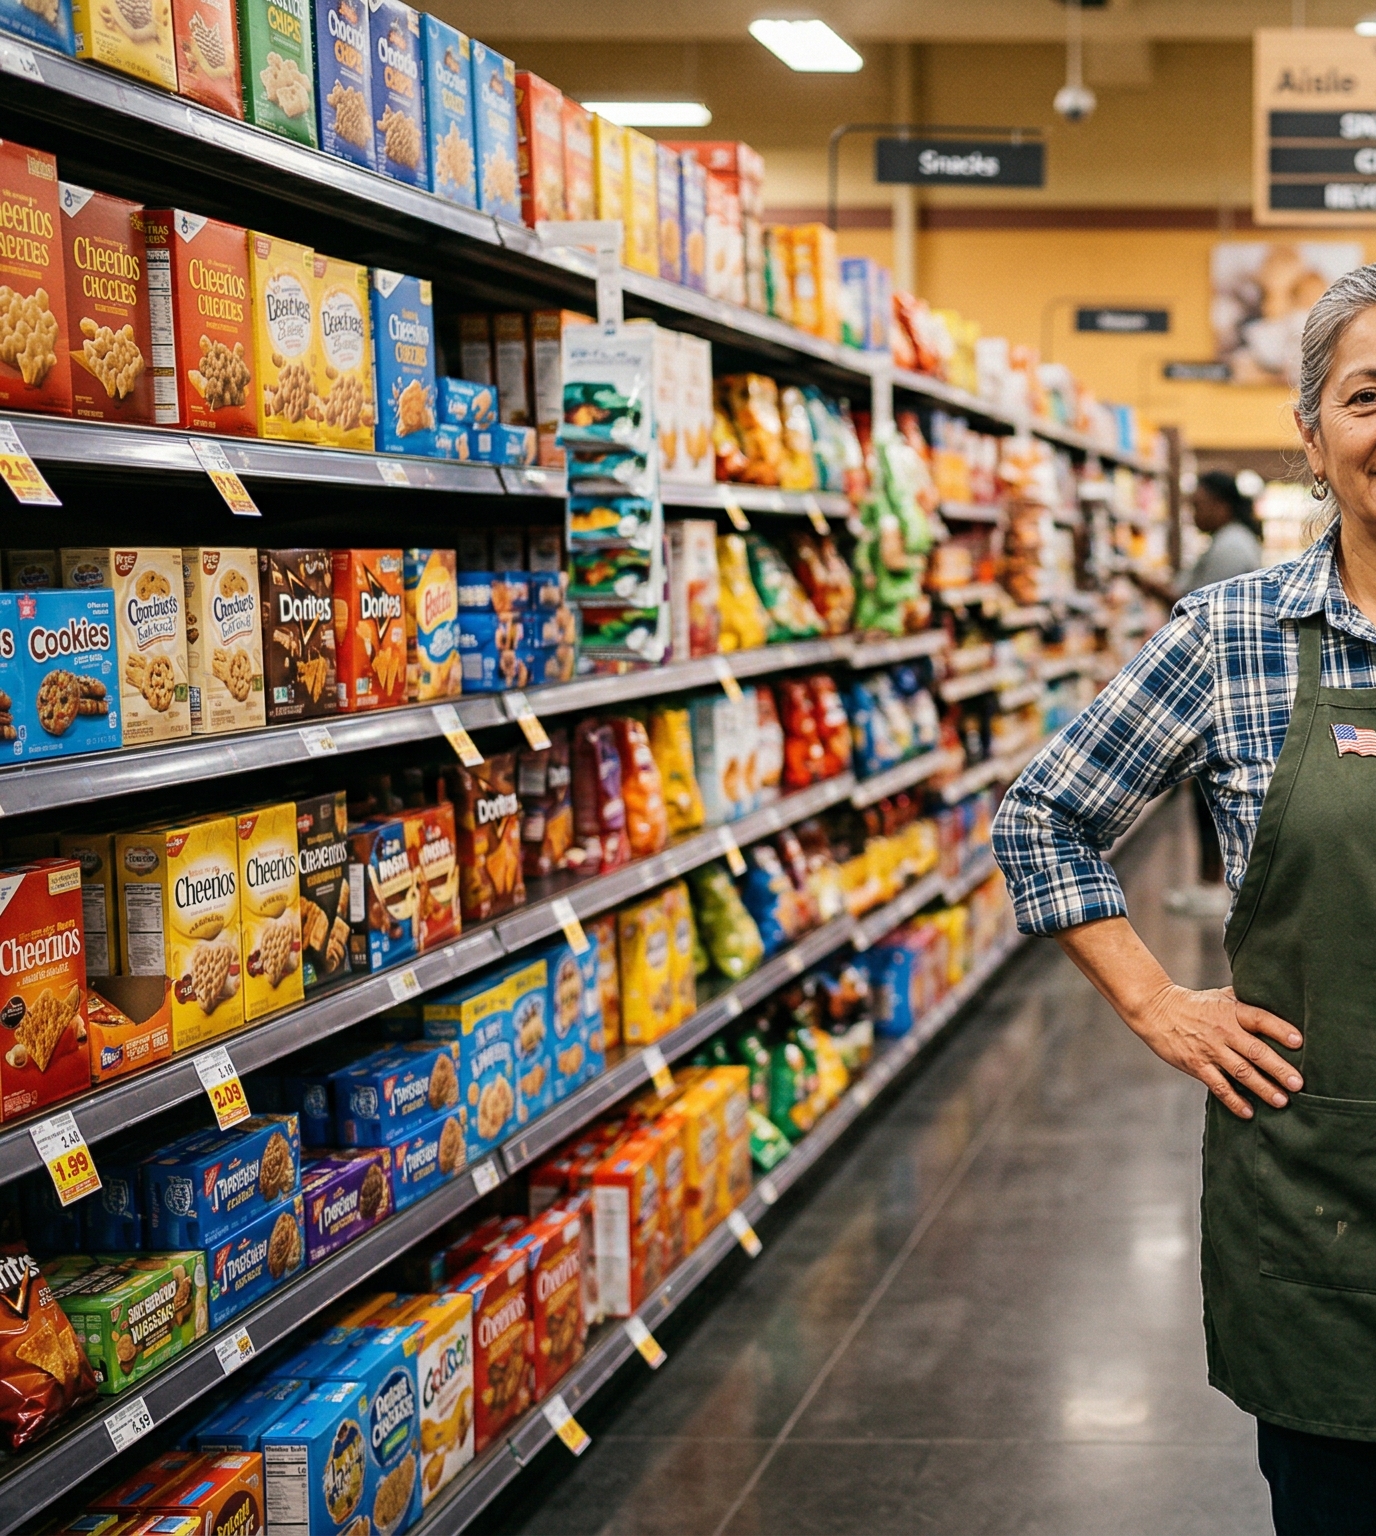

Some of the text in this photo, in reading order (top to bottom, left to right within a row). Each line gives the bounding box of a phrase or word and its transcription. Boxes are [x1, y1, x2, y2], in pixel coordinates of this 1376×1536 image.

[1278, 67, 1354, 92] Aisle
[918, 150, 1000, 177] Snacks
[279, 592, 332, 623] Doritos
[29, 617, 111, 663] Cookies
[214, 1083, 243, 1110] 2.09
